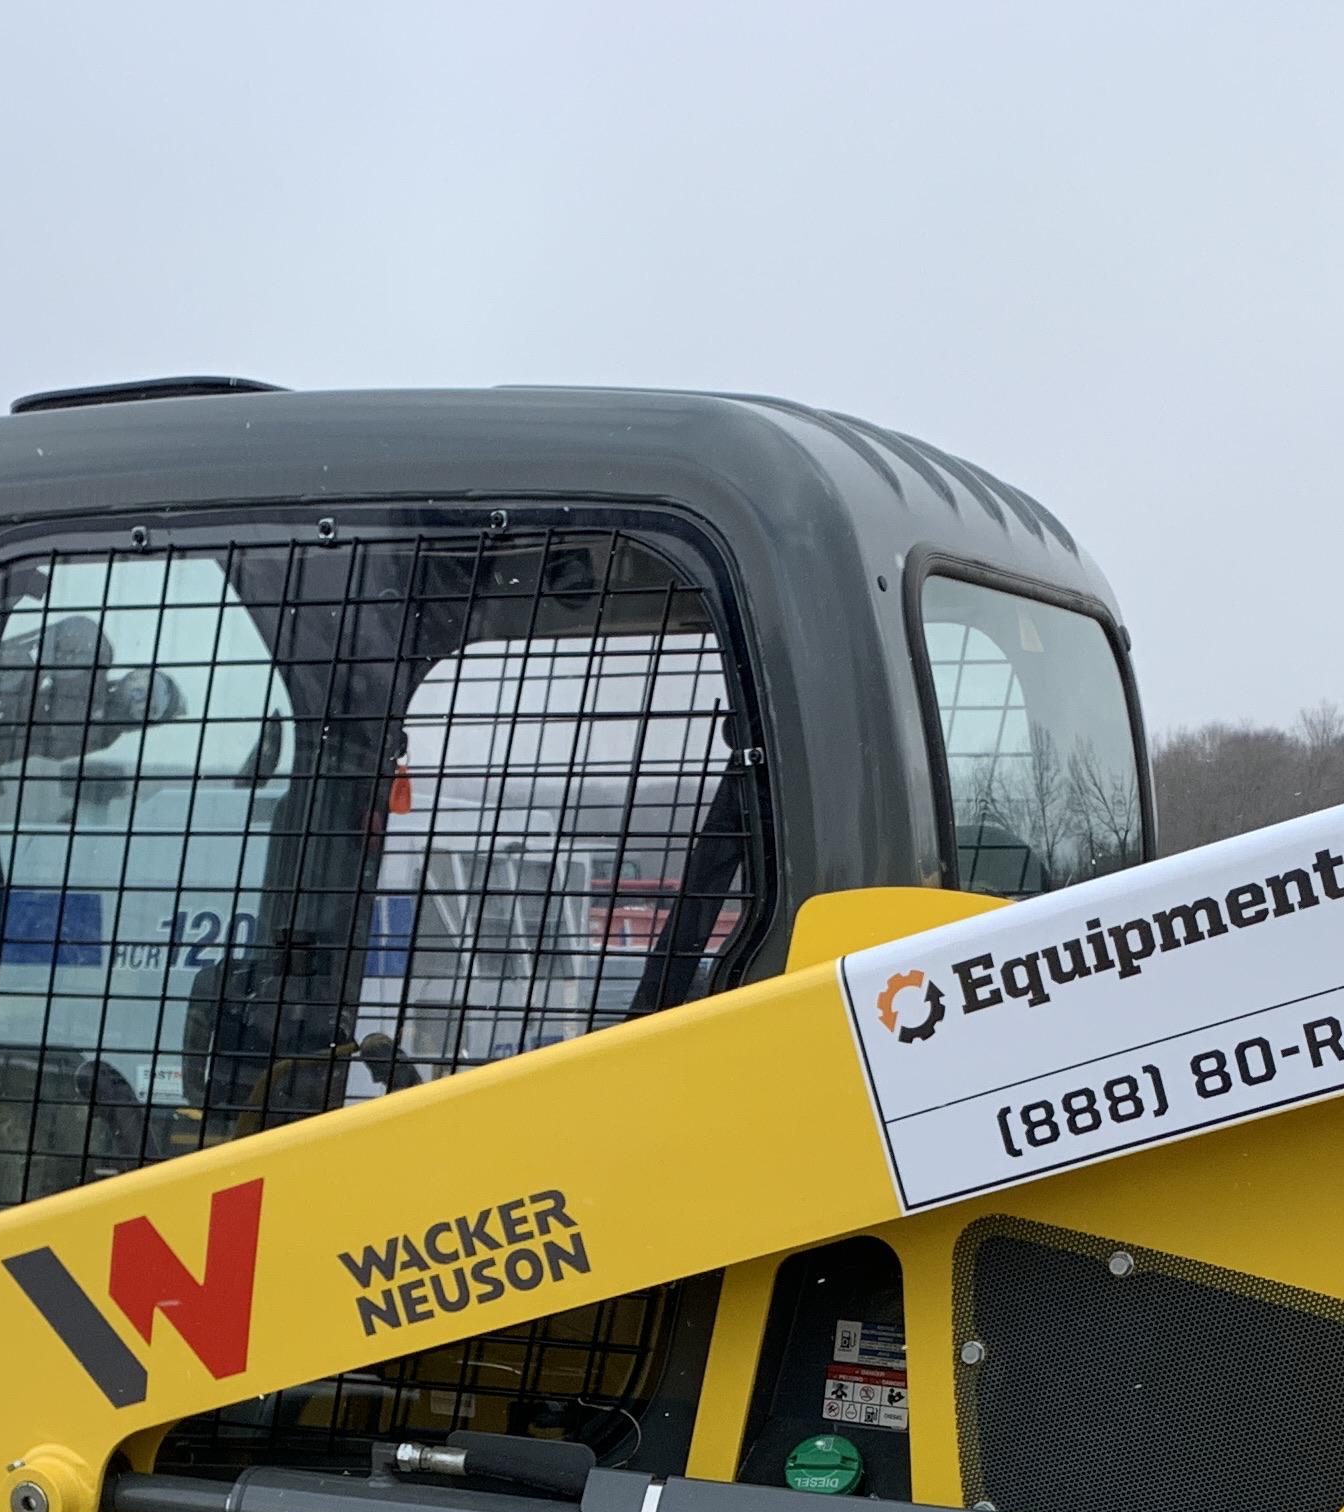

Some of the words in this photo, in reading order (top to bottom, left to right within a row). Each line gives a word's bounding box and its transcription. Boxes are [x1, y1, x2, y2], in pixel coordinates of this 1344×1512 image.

[997, 1064, 1169, 1158] (888)
[337, 1189, 578, 1288] WACKER
[356, 1232, 591, 1336] NEUSON
[794, 1477, 840, 1489] DIESEL
